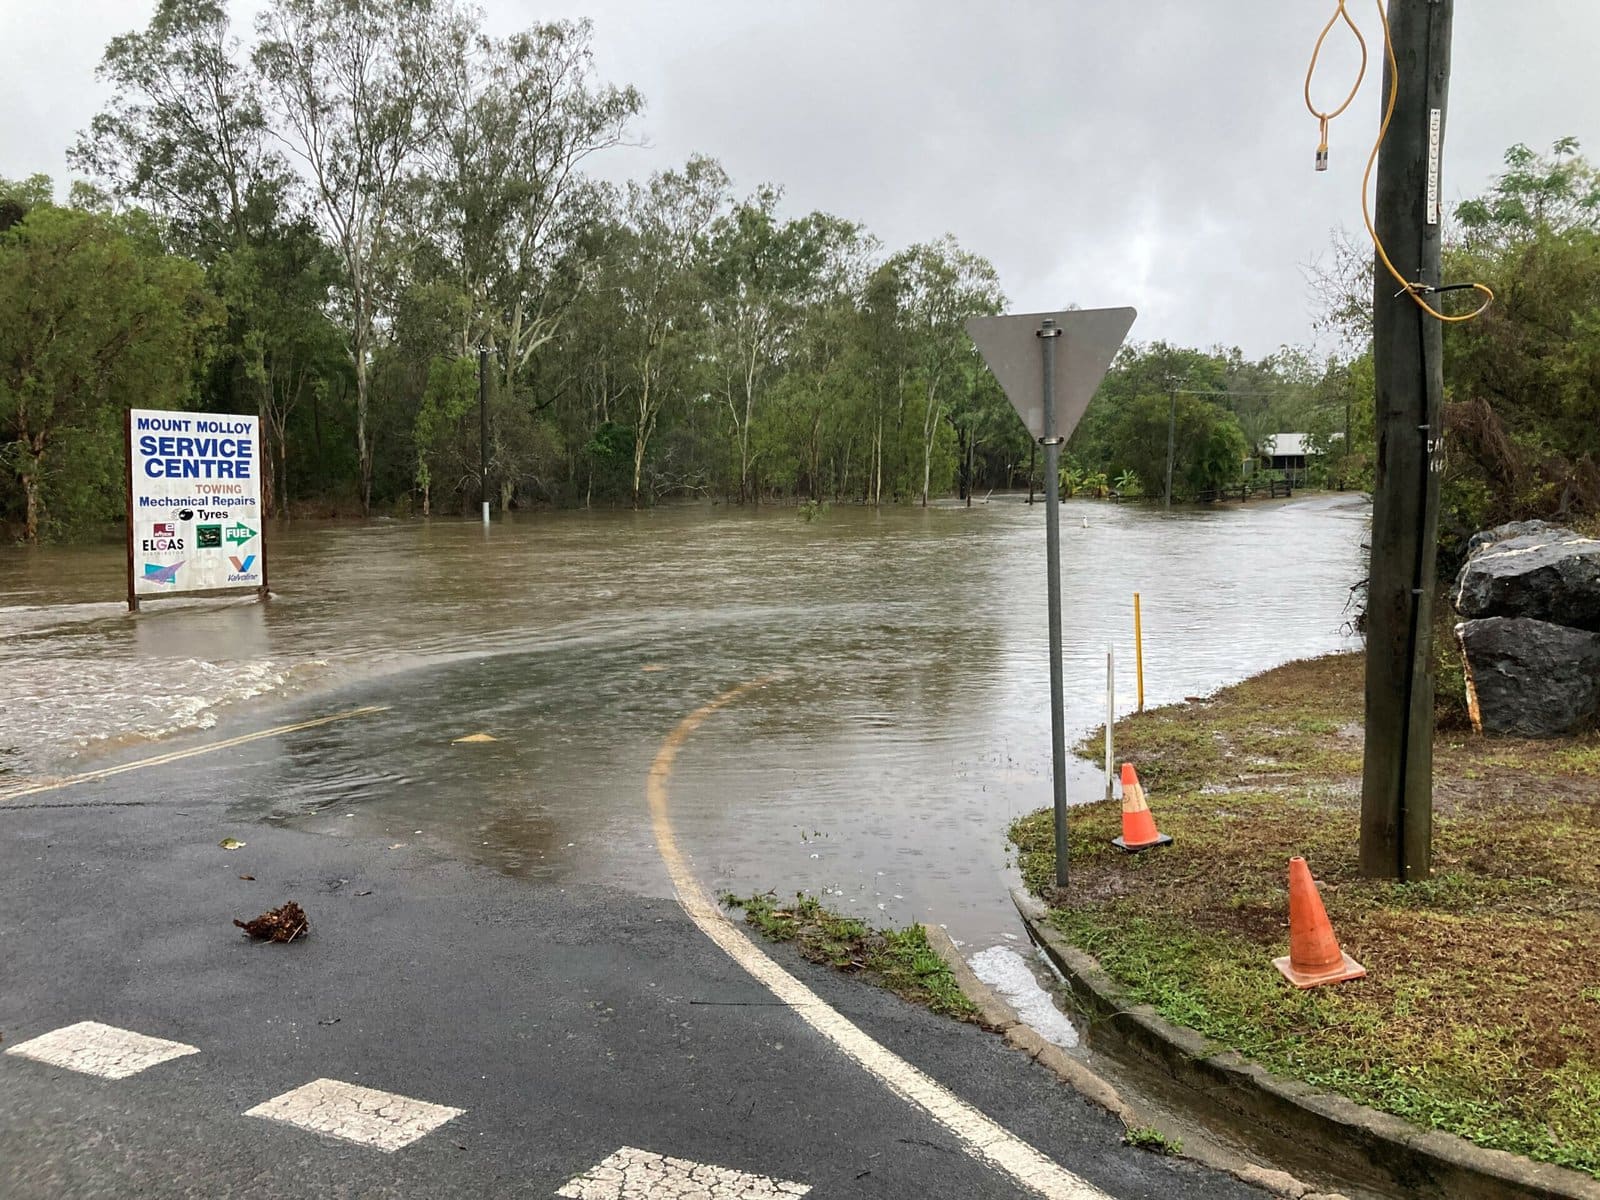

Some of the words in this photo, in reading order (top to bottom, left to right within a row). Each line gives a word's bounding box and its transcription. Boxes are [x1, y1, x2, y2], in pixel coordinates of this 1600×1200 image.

[138, 418, 191, 432] MOUNT
[197, 421, 252, 434] MOLLOY
[139, 435, 252, 458] SERVICE
[144, 458, 251, 479] CENTRE
[195, 484, 242, 495] TOWING
[139, 496, 208, 507] Mechanical
[212, 495, 256, 508] Repairs
[197, 509, 229, 521] Tyres
[226, 528, 252, 539] FUEL
[142, 538, 184, 551] ELGAS
